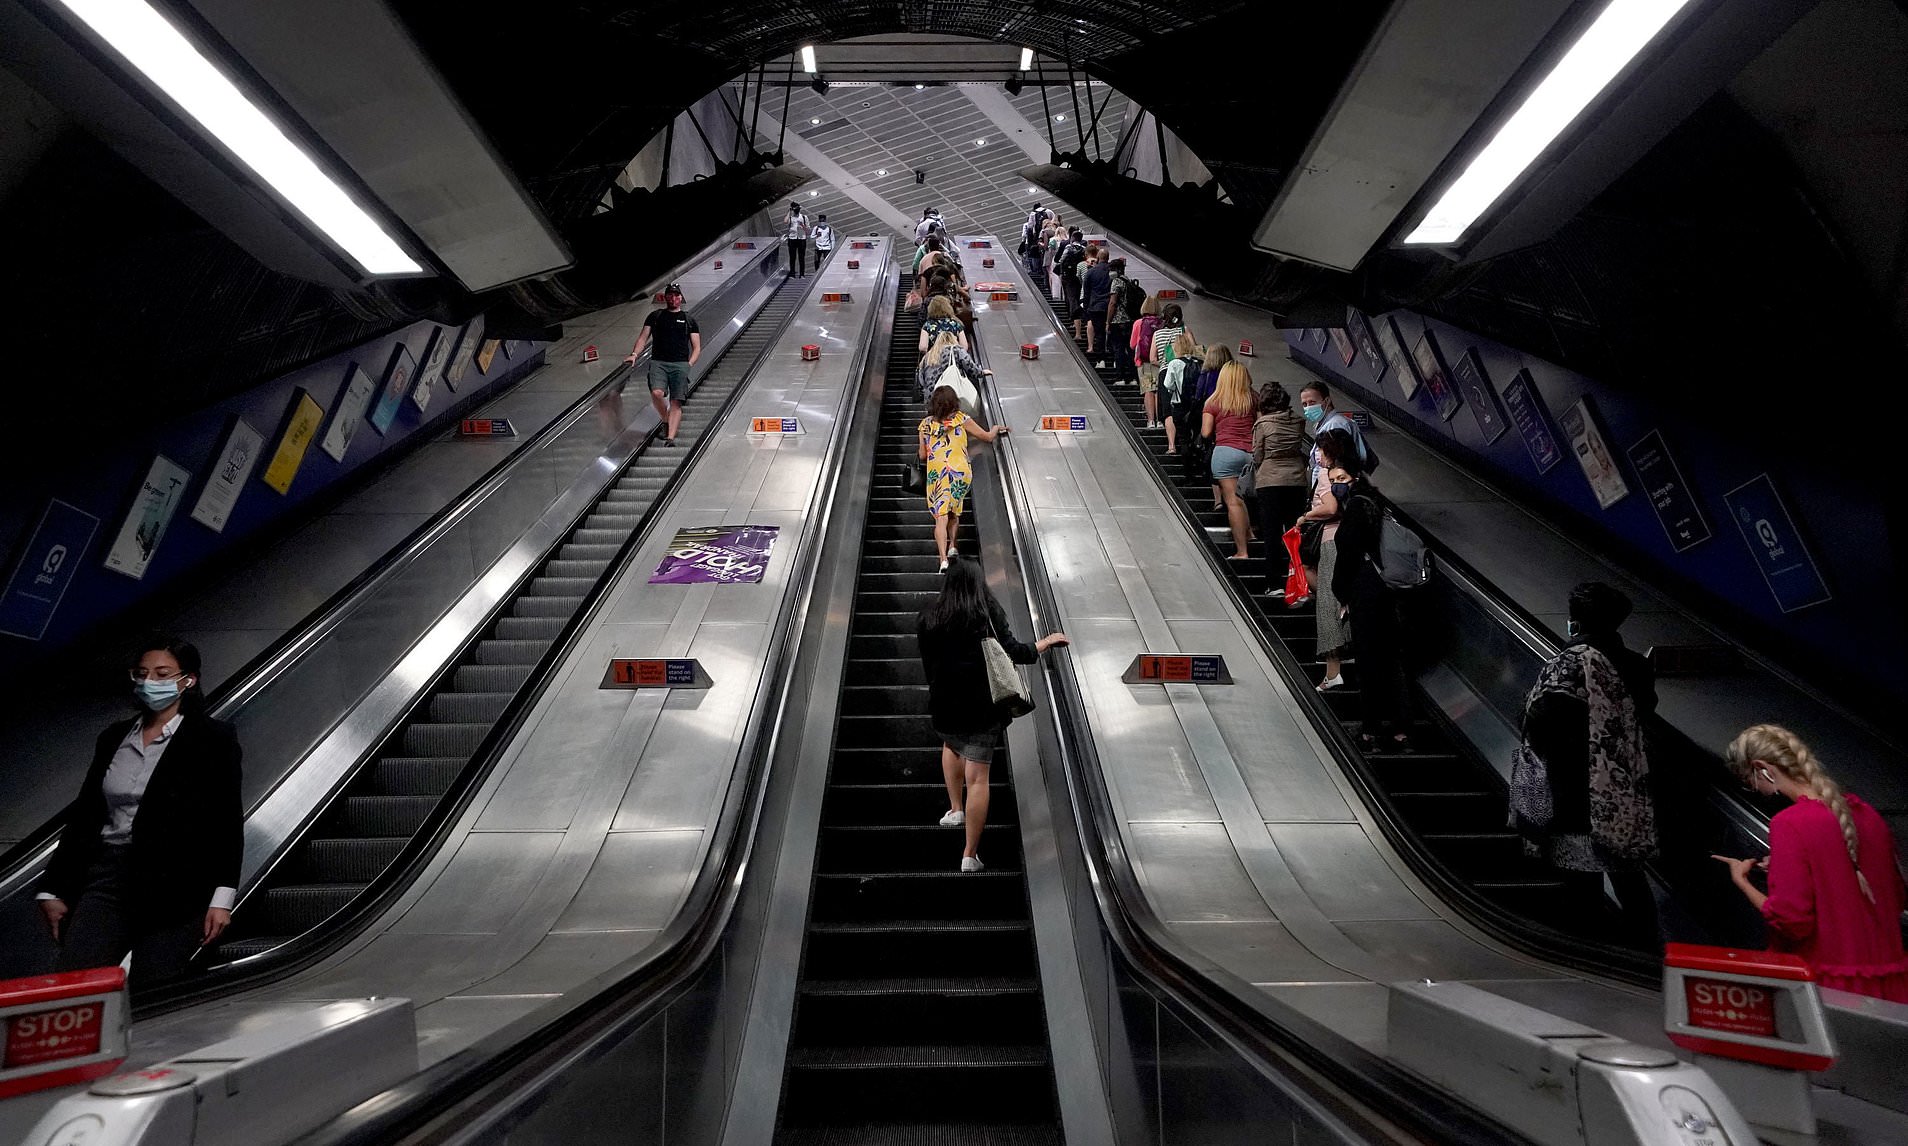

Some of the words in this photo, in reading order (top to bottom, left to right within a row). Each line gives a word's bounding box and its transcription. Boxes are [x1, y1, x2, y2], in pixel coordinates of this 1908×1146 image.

[673, 548, 763, 576] HOLD
[1694, 983, 1764, 1009] STOP
[16, 1007, 94, 1038] STOP
